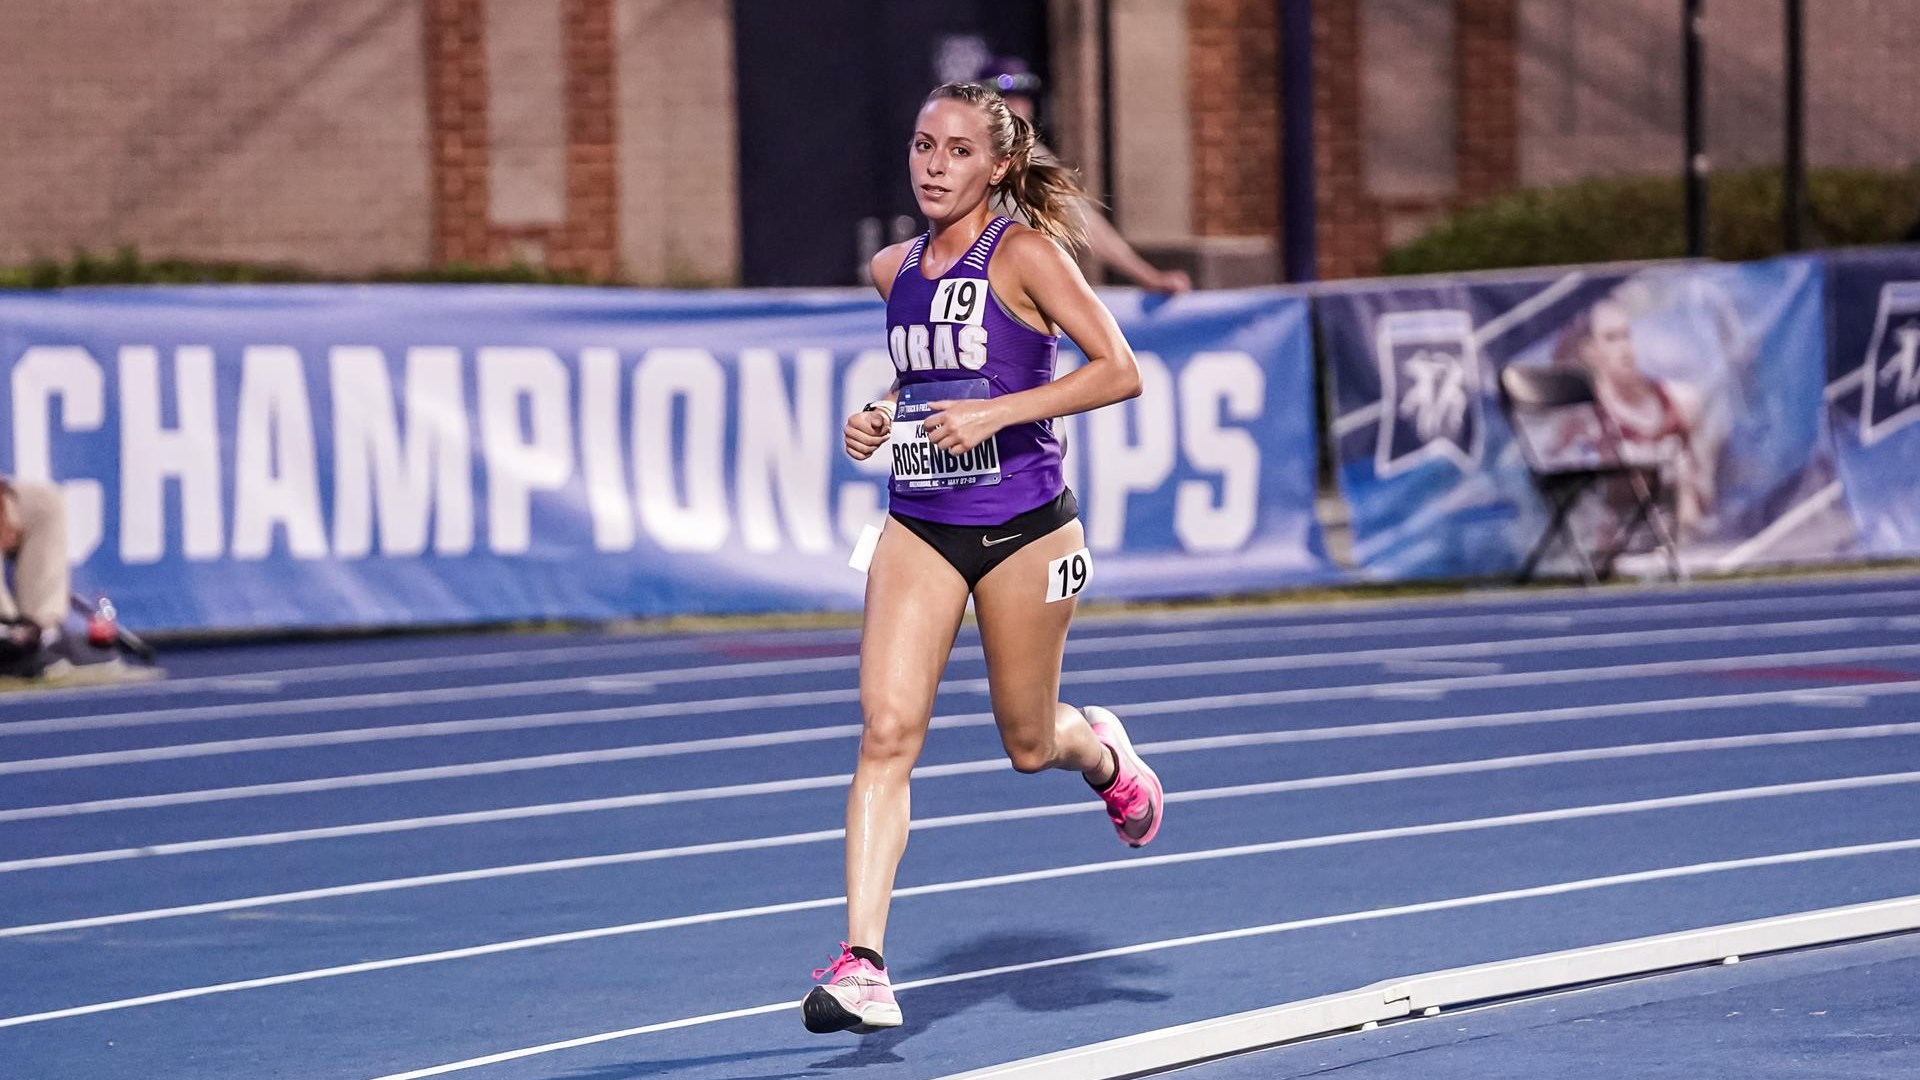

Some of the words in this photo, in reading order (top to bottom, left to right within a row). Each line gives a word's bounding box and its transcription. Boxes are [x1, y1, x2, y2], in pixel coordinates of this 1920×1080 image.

[943, 281, 978, 322] 19
[11, 345, 1266, 563] CHAMPIONPS
[892, 437, 997, 475] ROSENBUM
[1058, 554, 1087, 597] 19
